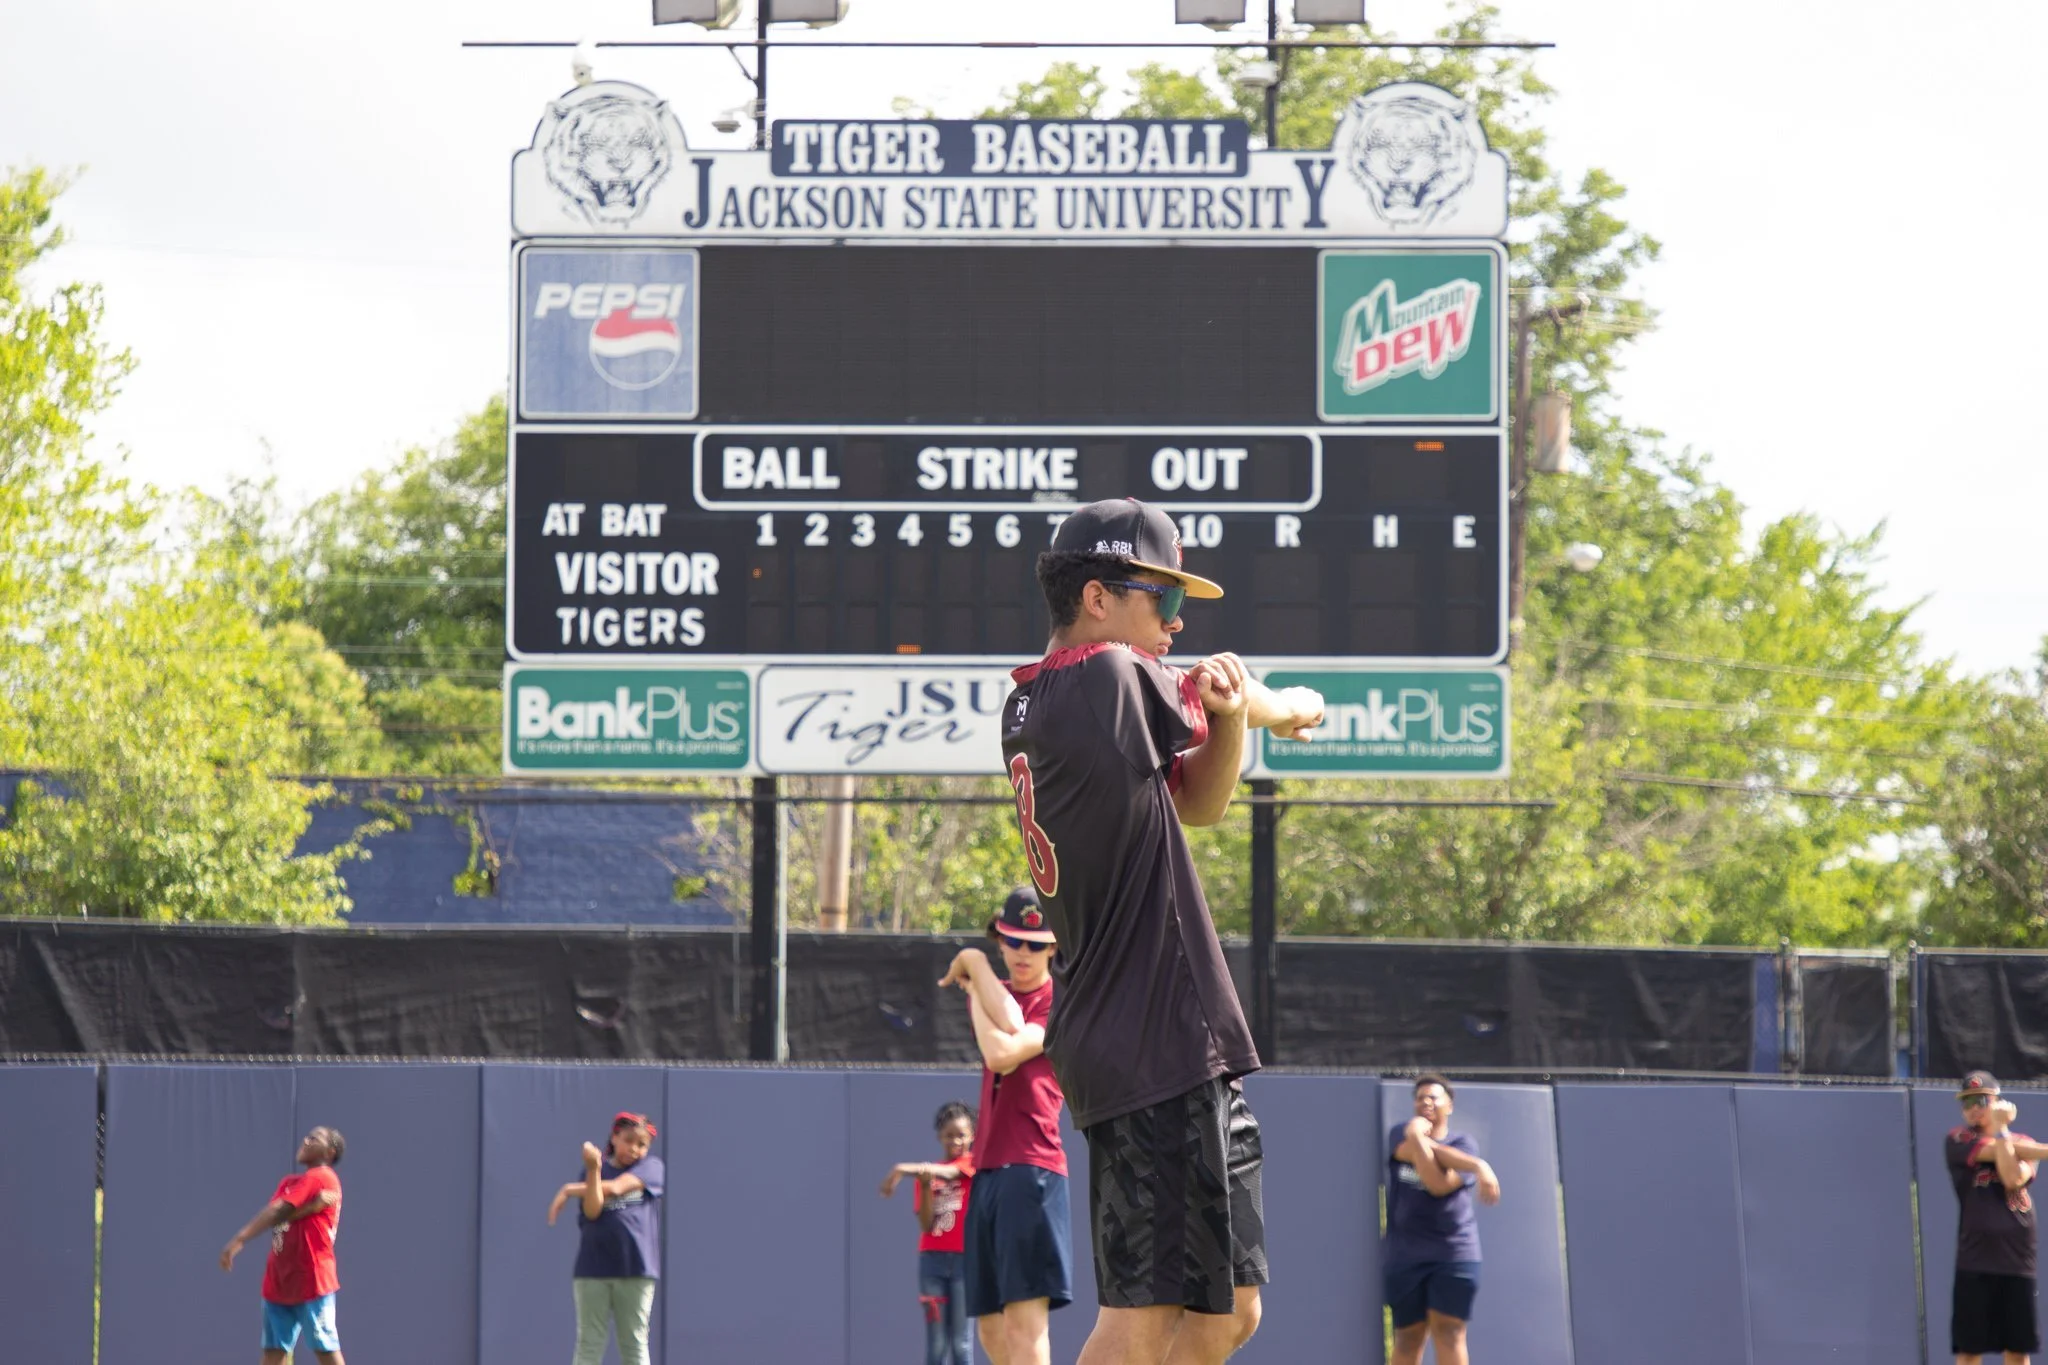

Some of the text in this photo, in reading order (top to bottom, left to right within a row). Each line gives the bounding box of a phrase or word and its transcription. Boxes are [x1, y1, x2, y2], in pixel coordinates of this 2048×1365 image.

[783, 122, 1237, 175] TIGER BASEBALL
[683, 157, 1336, 230] JACKSON STATE UNIVERSITY
[534, 282, 686, 320] PEPSI
[1347, 284, 1466, 345] Mountain
[722, 446, 1248, 491] BALL STRIKE OUT
[542, 503, 668, 537] AT BAT
[756, 512, 777, 546] 1
[804, 512, 829, 546] 2
[851, 513, 876, 547] 3
[897, 513, 924, 547] 4
[948, 513, 973, 547] 5
[995, 514, 1021, 548] 6
[1179, 514, 1223, 548] 10
[1275, 514, 1302, 548] R
[1373, 514, 1399, 548] H
[1453, 515, 1477, 548] E
[555, 551, 720, 596] VISITOR
[556, 607, 706, 647] TIGERS
[517, 685, 743, 740] BankPlus
[886, 679, 1009, 718] JSU
[777, 689, 974, 765] Tiger
